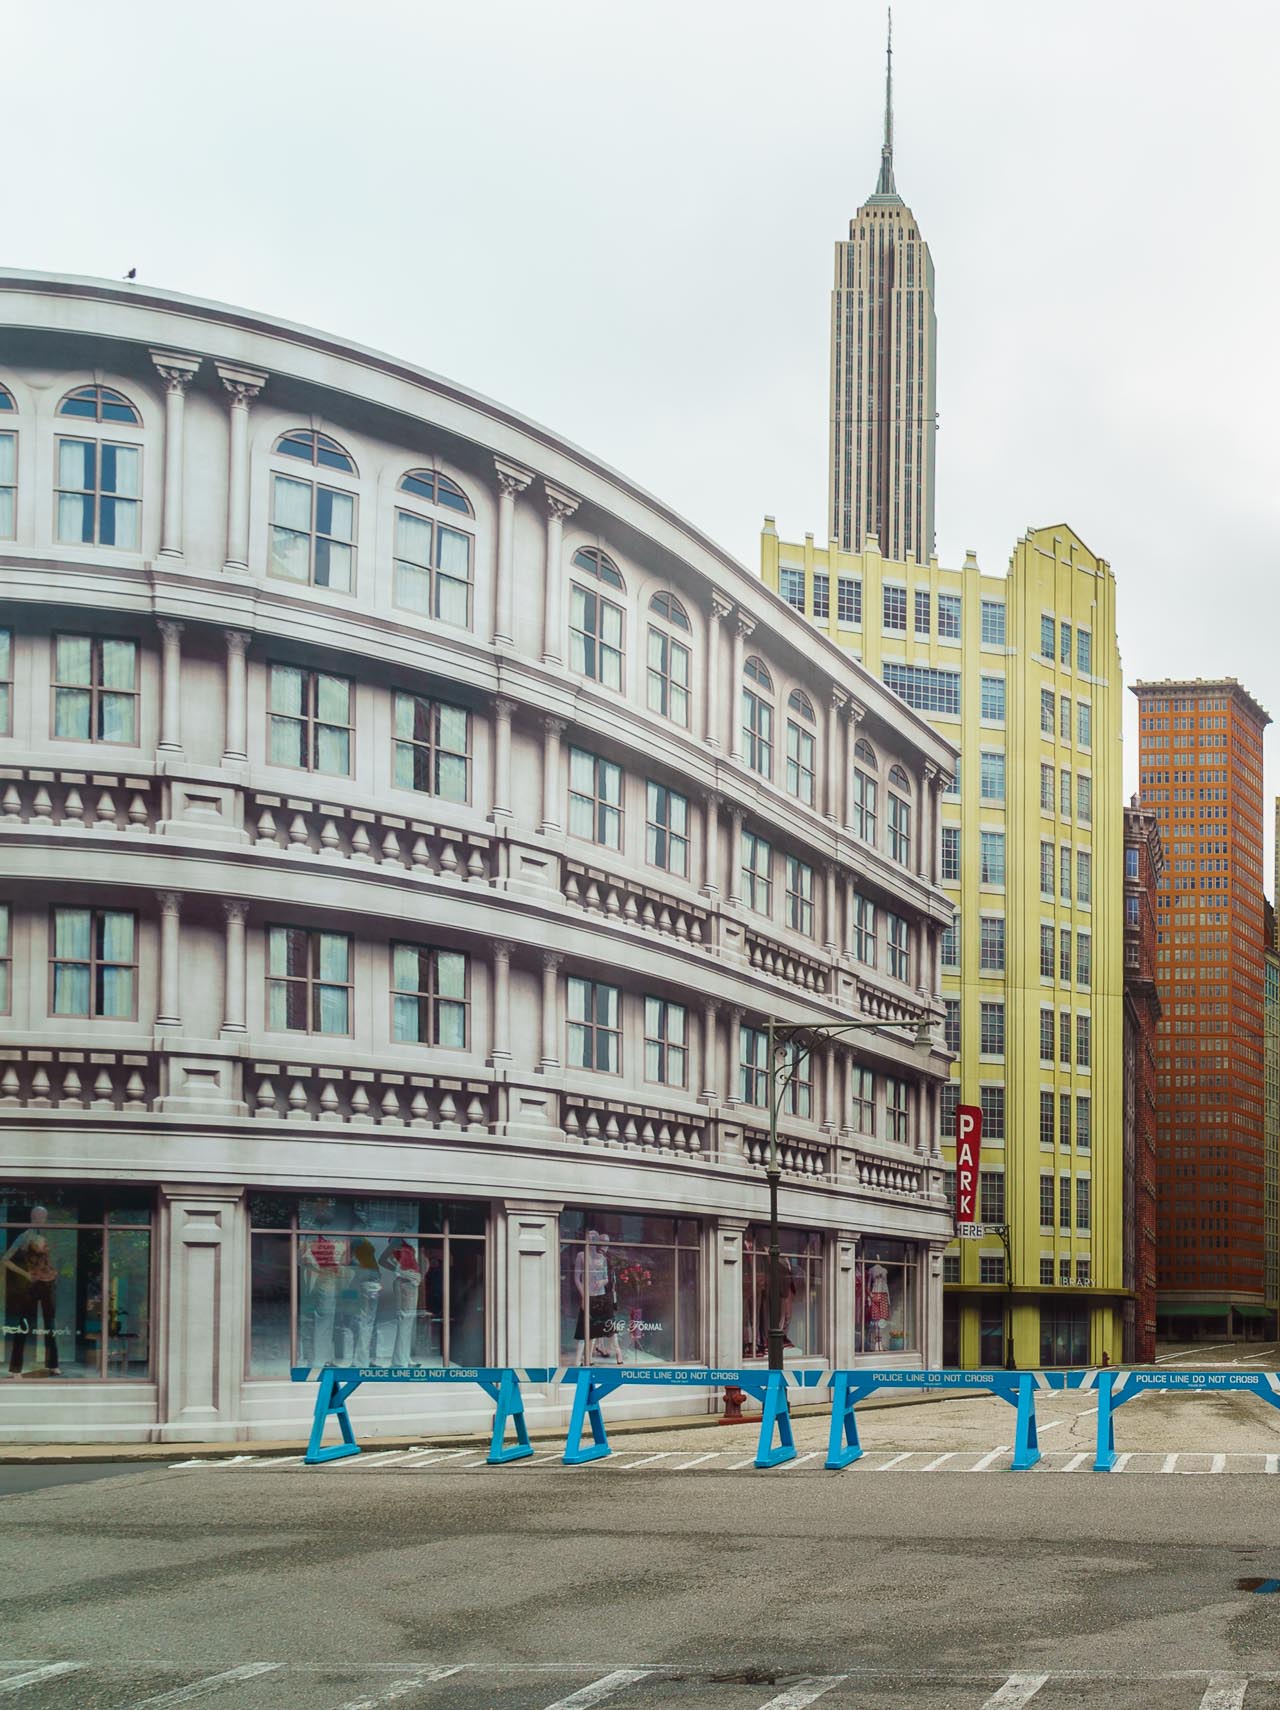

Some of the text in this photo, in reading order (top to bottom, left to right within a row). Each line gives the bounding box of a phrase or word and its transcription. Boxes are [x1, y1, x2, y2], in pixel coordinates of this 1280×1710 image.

[958, 1114, 975, 1214] PARK
[955, 1224, 982, 1236] HERE
[359, 1369, 478, 1378] POLICE LINE DO NOT CROSS
[621, 1370, 739, 1380] POLICE LINE DO NOT CROSS
[872, 1373, 994, 1383] POLICE LINE DO NOT CROSS
[1136, 1374, 1259, 1384] POLICE LINE DO NOT CROSS
